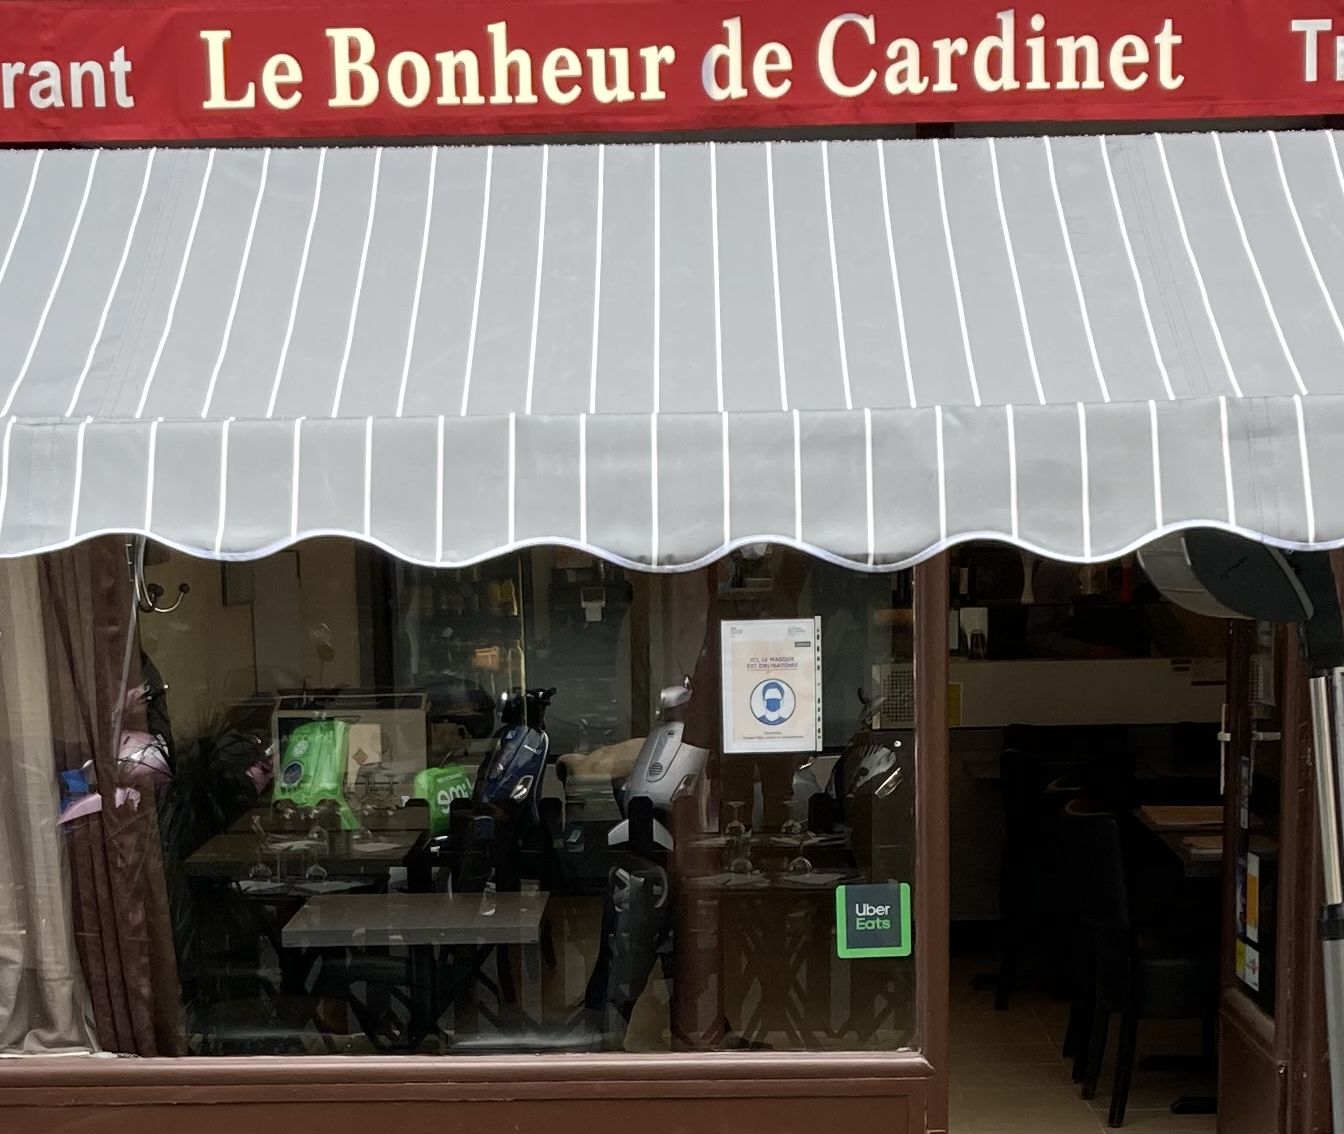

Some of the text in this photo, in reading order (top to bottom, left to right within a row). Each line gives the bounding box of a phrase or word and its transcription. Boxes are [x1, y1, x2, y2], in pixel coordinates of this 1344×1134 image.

[198, 8, 1186, 110] Le Bonheur de Cardinet
[855, 903, 890, 917] Uber
[855, 917, 891, 931] Eats
